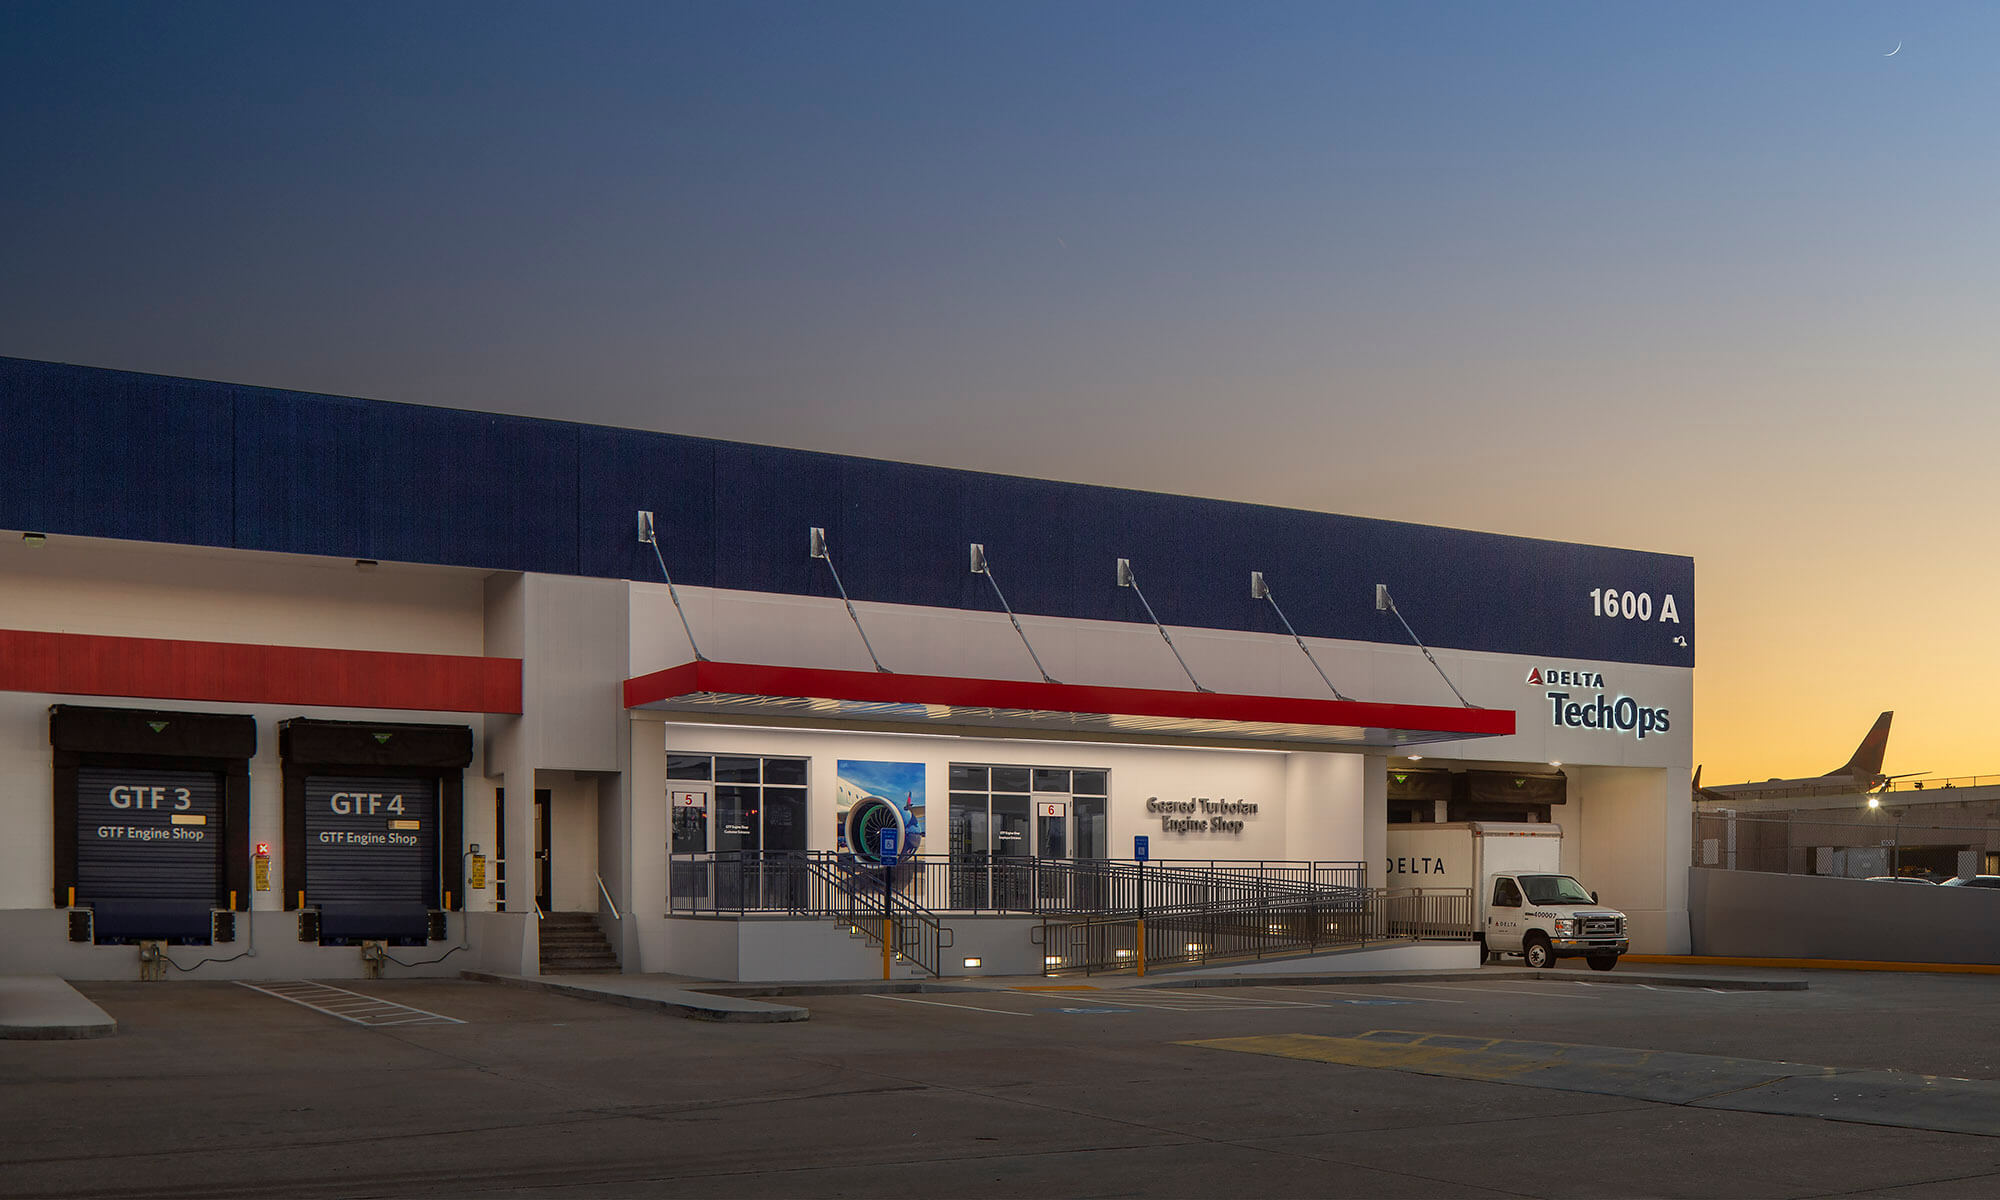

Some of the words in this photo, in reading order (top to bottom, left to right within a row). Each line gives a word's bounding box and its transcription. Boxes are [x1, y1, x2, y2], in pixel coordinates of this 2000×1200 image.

[1590, 588, 1652, 621] 1600
[1659, 594, 1680, 623] A
[1546, 670, 1605, 688] DELTA
[1547, 692, 1670, 739] TechOps
[109, 785, 166, 809] GTF
[174, 787, 192, 810] 3
[330, 792, 383, 815] GTF
[386, 794, 406, 816] 4
[685, 794, 693, 806] 5
[1146, 797, 1197, 814] Geared
[1198, 798, 1258, 815] Turbofan
[1048, 804, 1055, 816] 6
[97, 826, 125, 838] GTF
[127, 827, 170, 841] Engine
[172, 827, 204, 842] Shop
[1162, 815, 1208, 835] Engine
[1210, 816, 1244, 835] Shop
[319, 831, 344, 843] GTF
[346, 832, 386, 846] Engine
[388, 832, 417, 847] Shop
